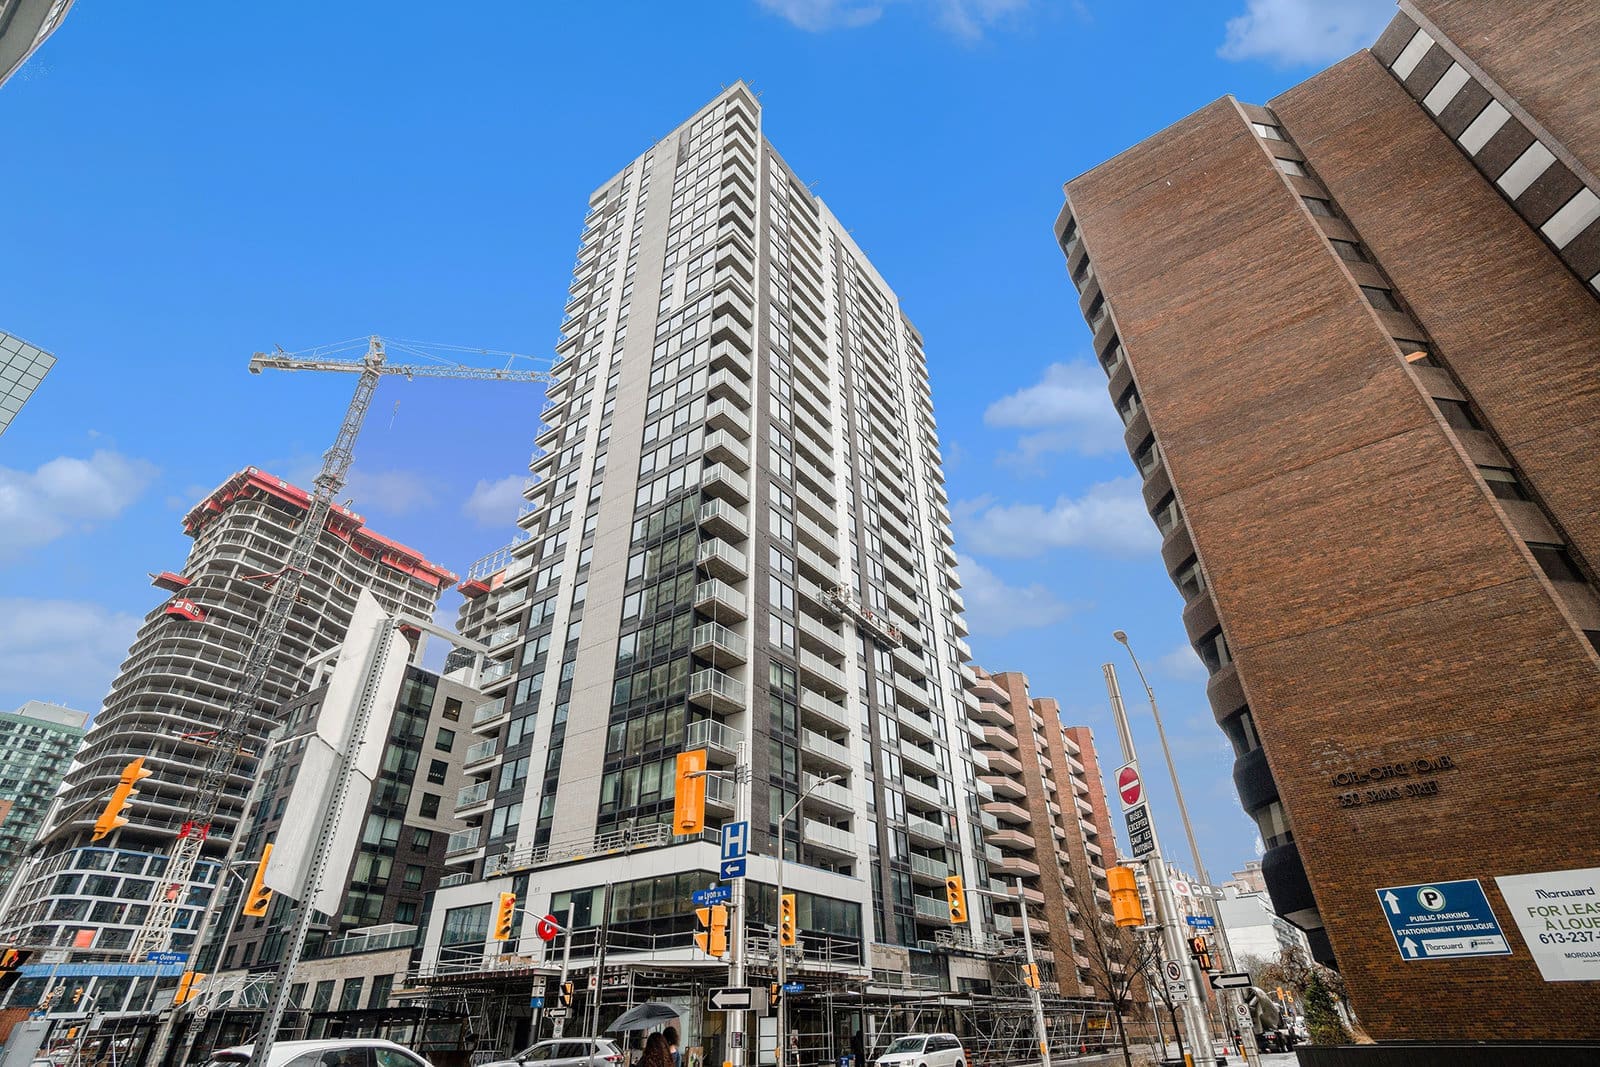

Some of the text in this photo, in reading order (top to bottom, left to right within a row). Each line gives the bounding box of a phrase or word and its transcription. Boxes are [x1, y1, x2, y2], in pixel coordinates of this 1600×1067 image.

[1411, 755, 1455, 772] TOWER
[1339, 780, 1440, 807] 350 SPARKS STREET
[725, 824, 744, 857] H
[1131, 830, 1152, 846] SAUF LES
[704, 890, 717, 901] Lyon
[1423, 891, 1438, 906] P
[1535, 887, 1595, 899] Morguard
[1409, 911, 1470, 923] PUBLIC PARKING
[1527, 905, 1562, 918] FOR
[1397, 922, 1495, 936] STATIONNEMENT PUBLIQUE
[1544, 917, 1600, 931] À LOUE
[1539, 931, 1600, 944] 613-237-
[1425, 943, 1464, 951] Morguard
